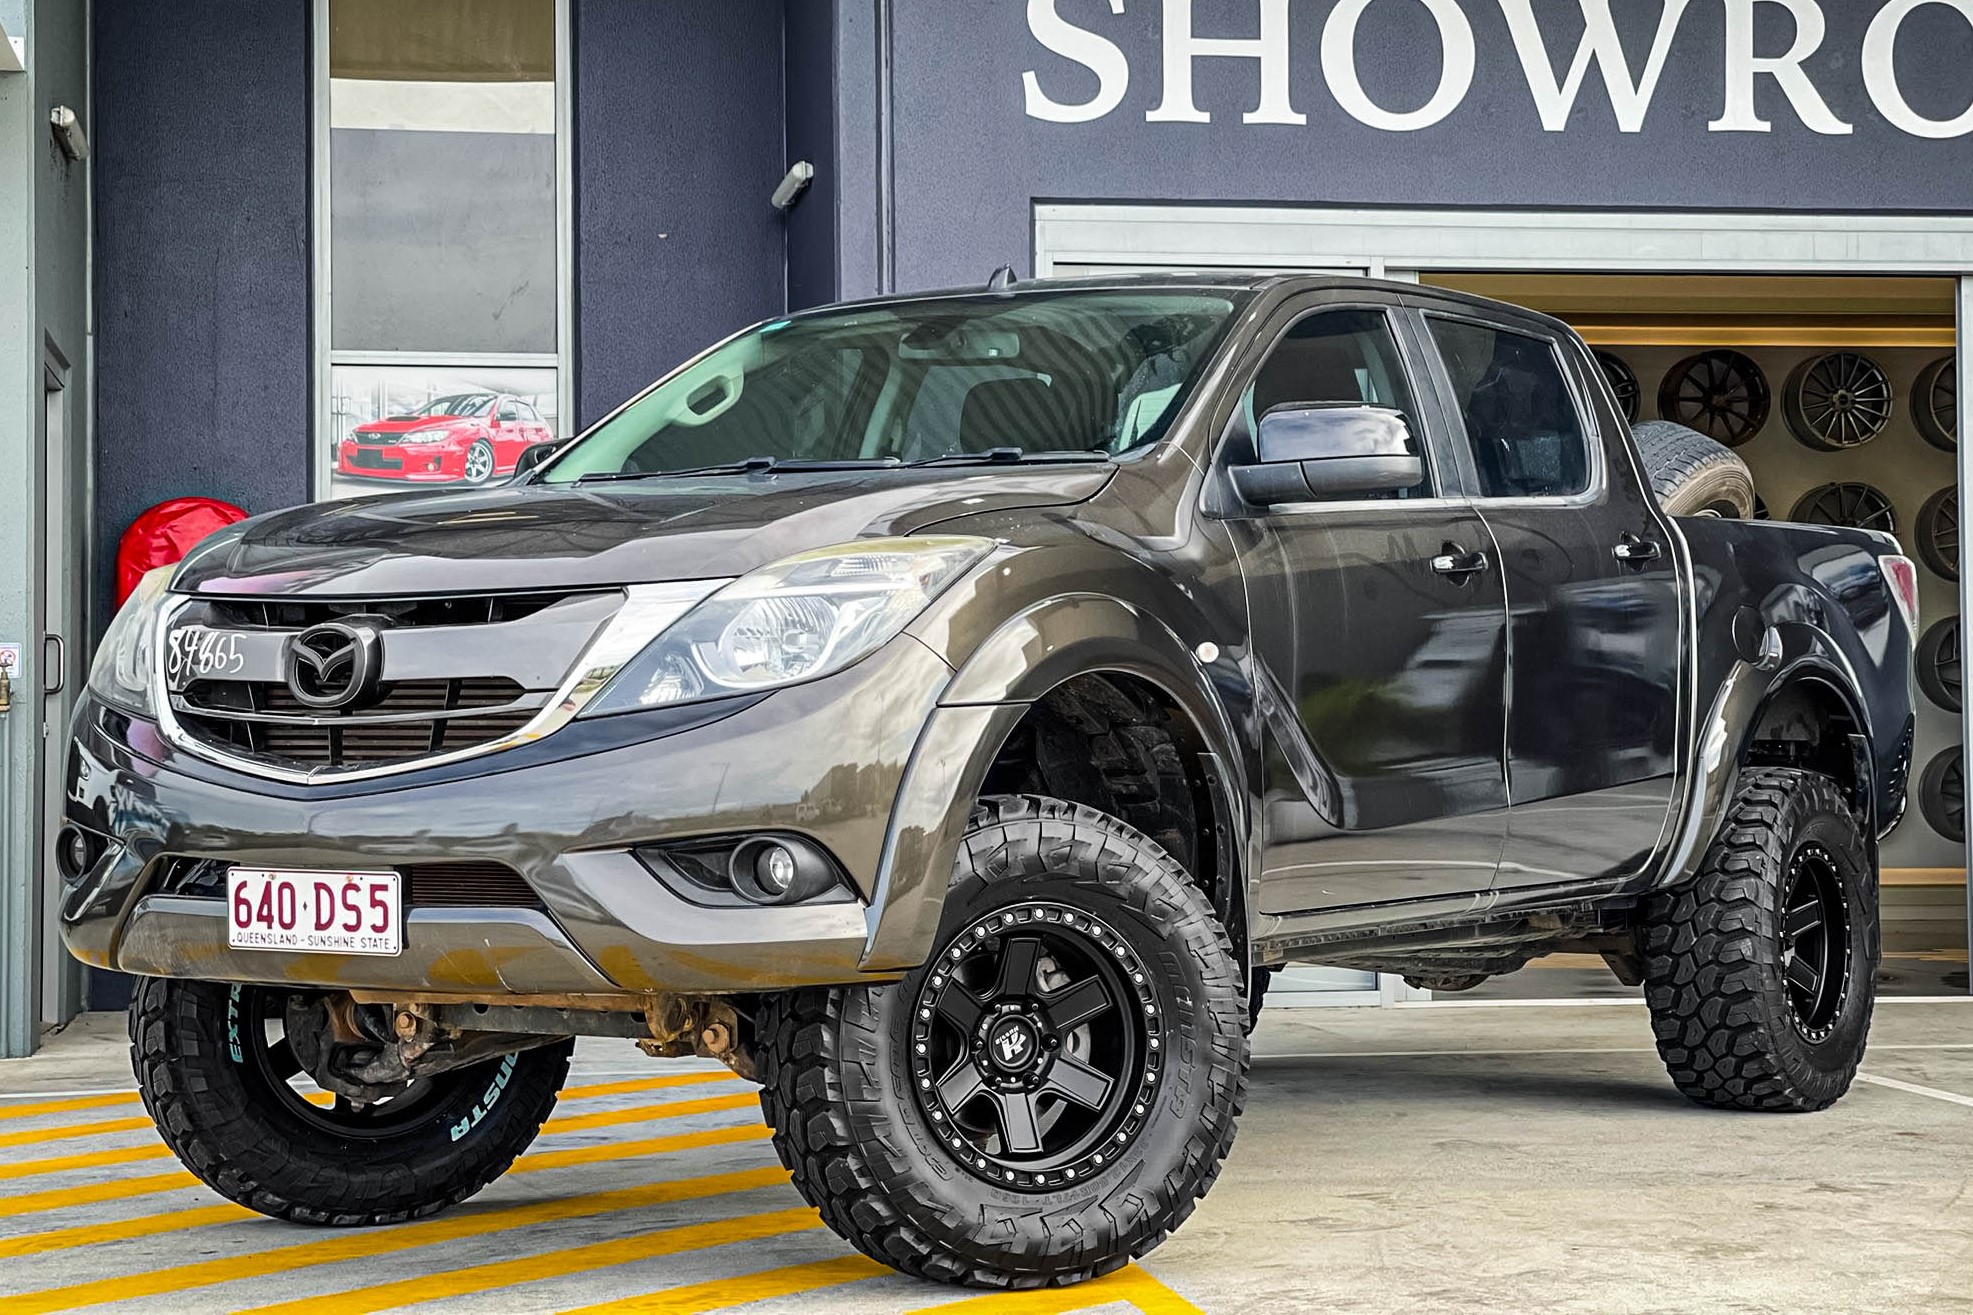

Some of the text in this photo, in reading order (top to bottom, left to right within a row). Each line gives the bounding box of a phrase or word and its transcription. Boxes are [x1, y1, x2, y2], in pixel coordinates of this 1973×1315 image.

[234, 880, 389, 933] 640 DS5
[237, 932, 298, 945] QUEENSLAND
[308, 935, 356, 948] SUNSHINE
[361, 938, 391, 950] STATE
